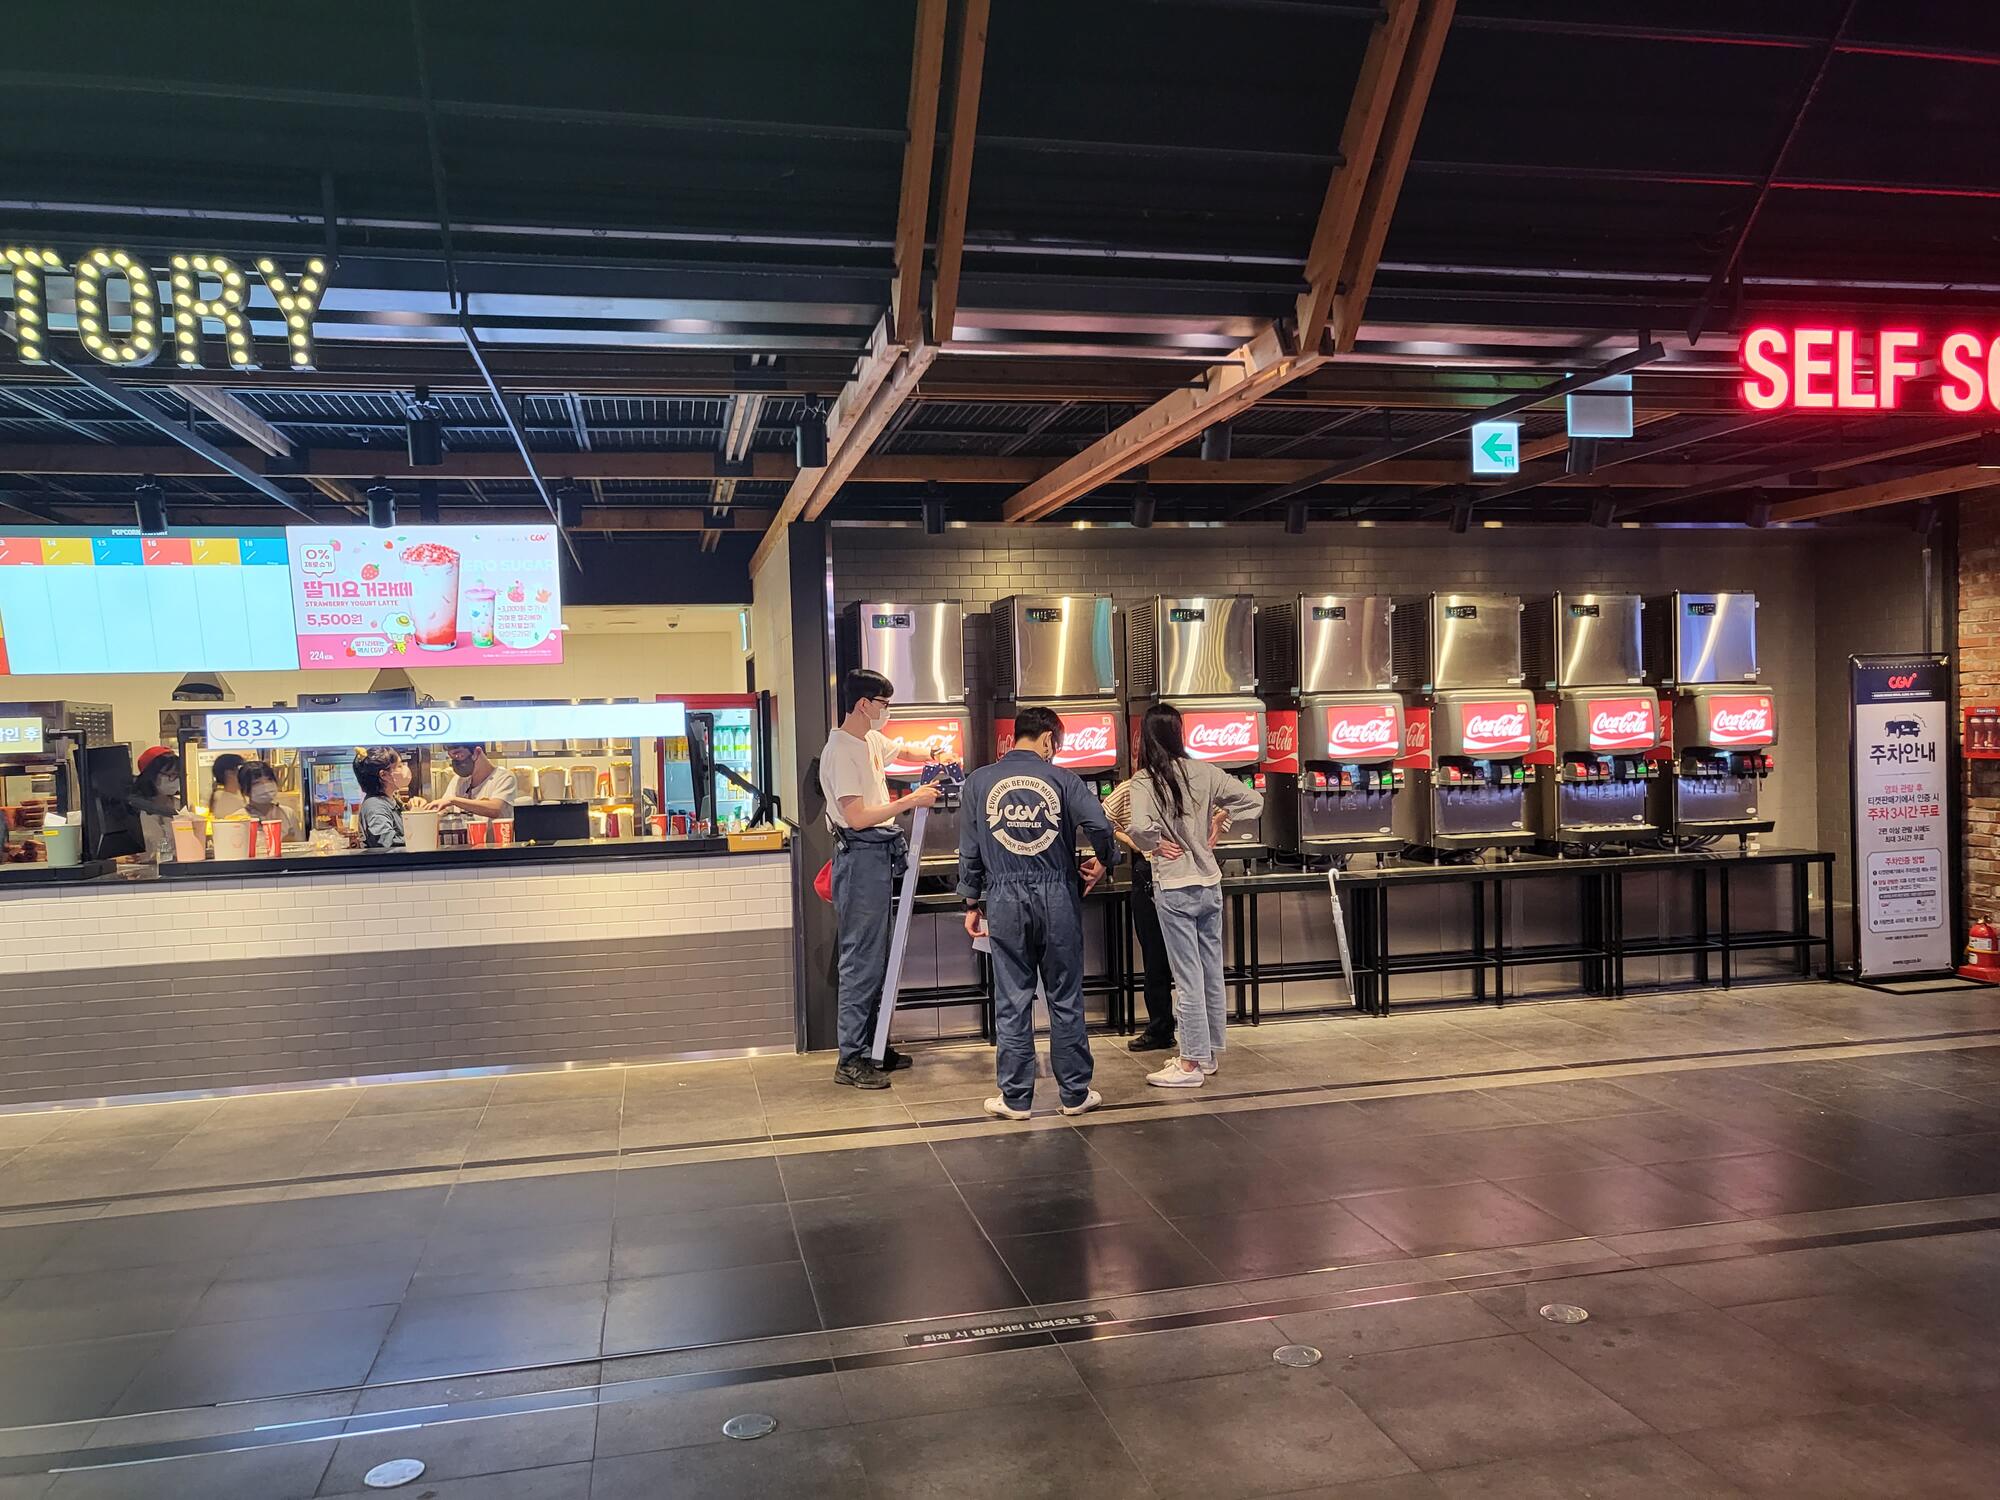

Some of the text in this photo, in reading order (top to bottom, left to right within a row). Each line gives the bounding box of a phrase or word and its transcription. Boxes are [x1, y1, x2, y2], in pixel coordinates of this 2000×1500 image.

[1743, 328, 2000, 412] SELF S
[530, 533, 548, 541] CGV
[306, 549, 330, 560] 0%
[307, 613, 363, 626] 5,500원
[1888, 673, 1917, 689] CGV
[223, 719, 278, 737] 1834
[389, 715, 440, 733] 1730
[1466, 714, 1525, 738] Coca-Cola
[1592, 710, 1648, 734] Coca-Cola
[1713, 708, 1768, 732] Coca-Cola
[24, 726, 40, 742] 후
[1189, 722, 1253, 748] Coca-Cola
[1331, 718, 1393, 743] Coca-Cola
[1869, 741, 1936, 765] 주차안내
[988, 779, 1058, 811] EVOLVING BEYOND MOVIES
[1884, 783, 1923, 794] 영화 관람 후
[1867, 793, 1940, 806] 티켓판매기에서 인증 시
[1004, 804, 1041, 821] CGV
[1867, 804, 1940, 821] 주차 3시간 무료
[1006, 821, 1042, 829] CULTUREPLEX
[1002, 835, 1016, 849] UNDER
[1885, 855, 1925, 866] 주차인증 방법
[922, 1332, 951, 1342] 화재
[955, 1330, 969, 1338] 시
[1028, 1317, 1081, 1329] 내려오는
[1083, 1314, 1098, 1323] 곳
